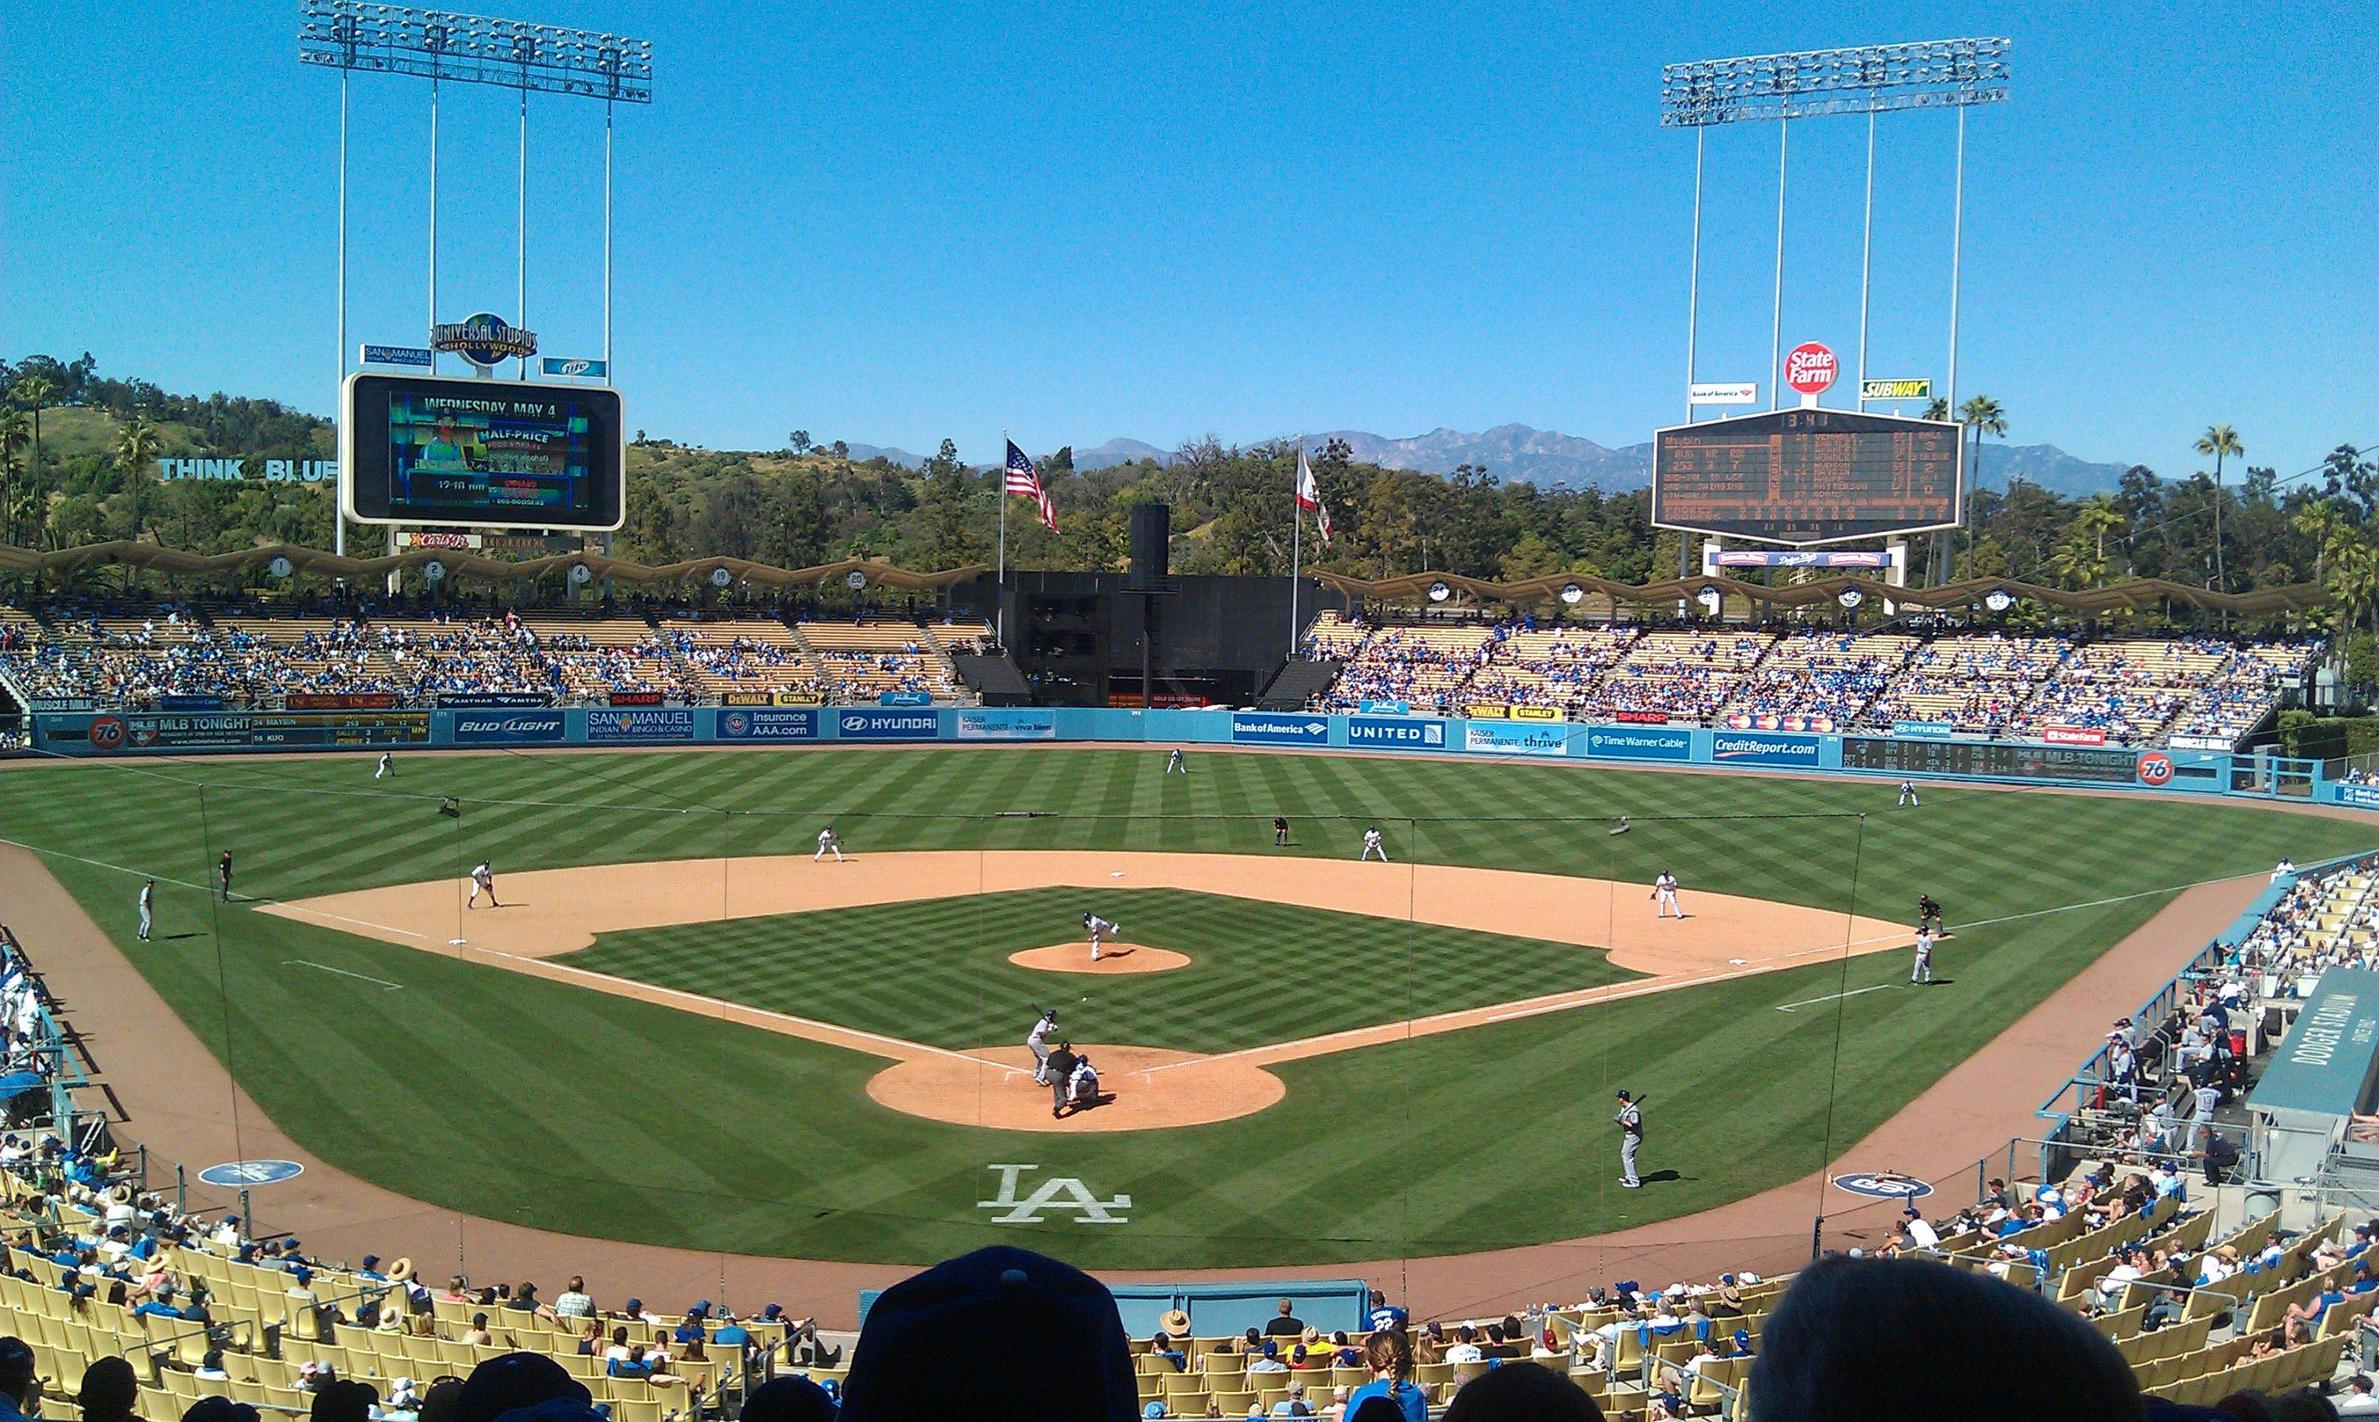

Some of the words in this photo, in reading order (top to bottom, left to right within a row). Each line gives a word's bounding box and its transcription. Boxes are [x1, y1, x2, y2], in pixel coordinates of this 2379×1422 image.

[437, 324, 493, 343] UNIVERSAL
[496, 325, 538, 349] STUDIOS
[366, 347, 385, 356] SAN
[391, 348, 430, 360] MANUEL
[450, 341, 525, 355] HOLLYWOOD
[1790, 350, 1833, 369] State
[1788, 366, 1833, 384] Farm
[1863, 381, 1928, 398] SUBWAY
[513, 402, 543, 417] MAY
[480, 429, 549, 444] HALF-PRICE
[157, 458, 245, 481] THINK
[265, 459, 339, 482] BLUE
[851, 574, 862, 583] 20
[31, 699, 68, 710] MUSCLE
[69, 699, 93, 710] MILK
[611, 694, 661, 705] SHARP
[783, 695, 817, 703] STANLEY
[589, 712, 619, 725] SAN
[632, 712, 692, 725] MANUEL
[753, 712, 807, 722] Insurance
[1519, 709, 1553, 718] STANLEY
[1618, 712, 1667, 722] SHARP
[160, 719, 189, 730] MLB
[192, 718, 252, 730] TONIGHT
[460, 721, 500, 732] BUD
[507, 721, 560, 731] LIGHT
[589, 726, 619, 734] INDIAN
[871, 718, 937, 729] HYUNDAI
[962, 723, 1009, 731] PERMANENTE
[1014, 723, 1032, 731] viva
[1034, 723, 1052, 731] bien
[1234, 722, 1257, 732] Bank
[1257, 722, 1267, 733] of
[1267, 723, 1304, 734] America
[95, 721, 120, 741] 76
[752, 726, 807, 735] AAA.com
[1350, 726, 1421, 739] UNITED
[1470, 729, 1495, 737] KAISER
[1470, 737, 1520, 747] PERMANENTE
[1524, 735, 1562, 749] thrive
[1602, 735, 1625, 746] Time
[1625, 736, 1657, 747] Warner
[1658, 737, 1684, 748] Cable
[1715, 739, 1815, 755] CreditReport.com
[2045, 750, 2075, 762] MLB
[2077, 753, 2137, 766] TONIGHT
[2143, 759, 2168, 779] 76
[2291, 1027, 2343, 1066] DODGER
[977, 1164, 1132, 1224] LA
